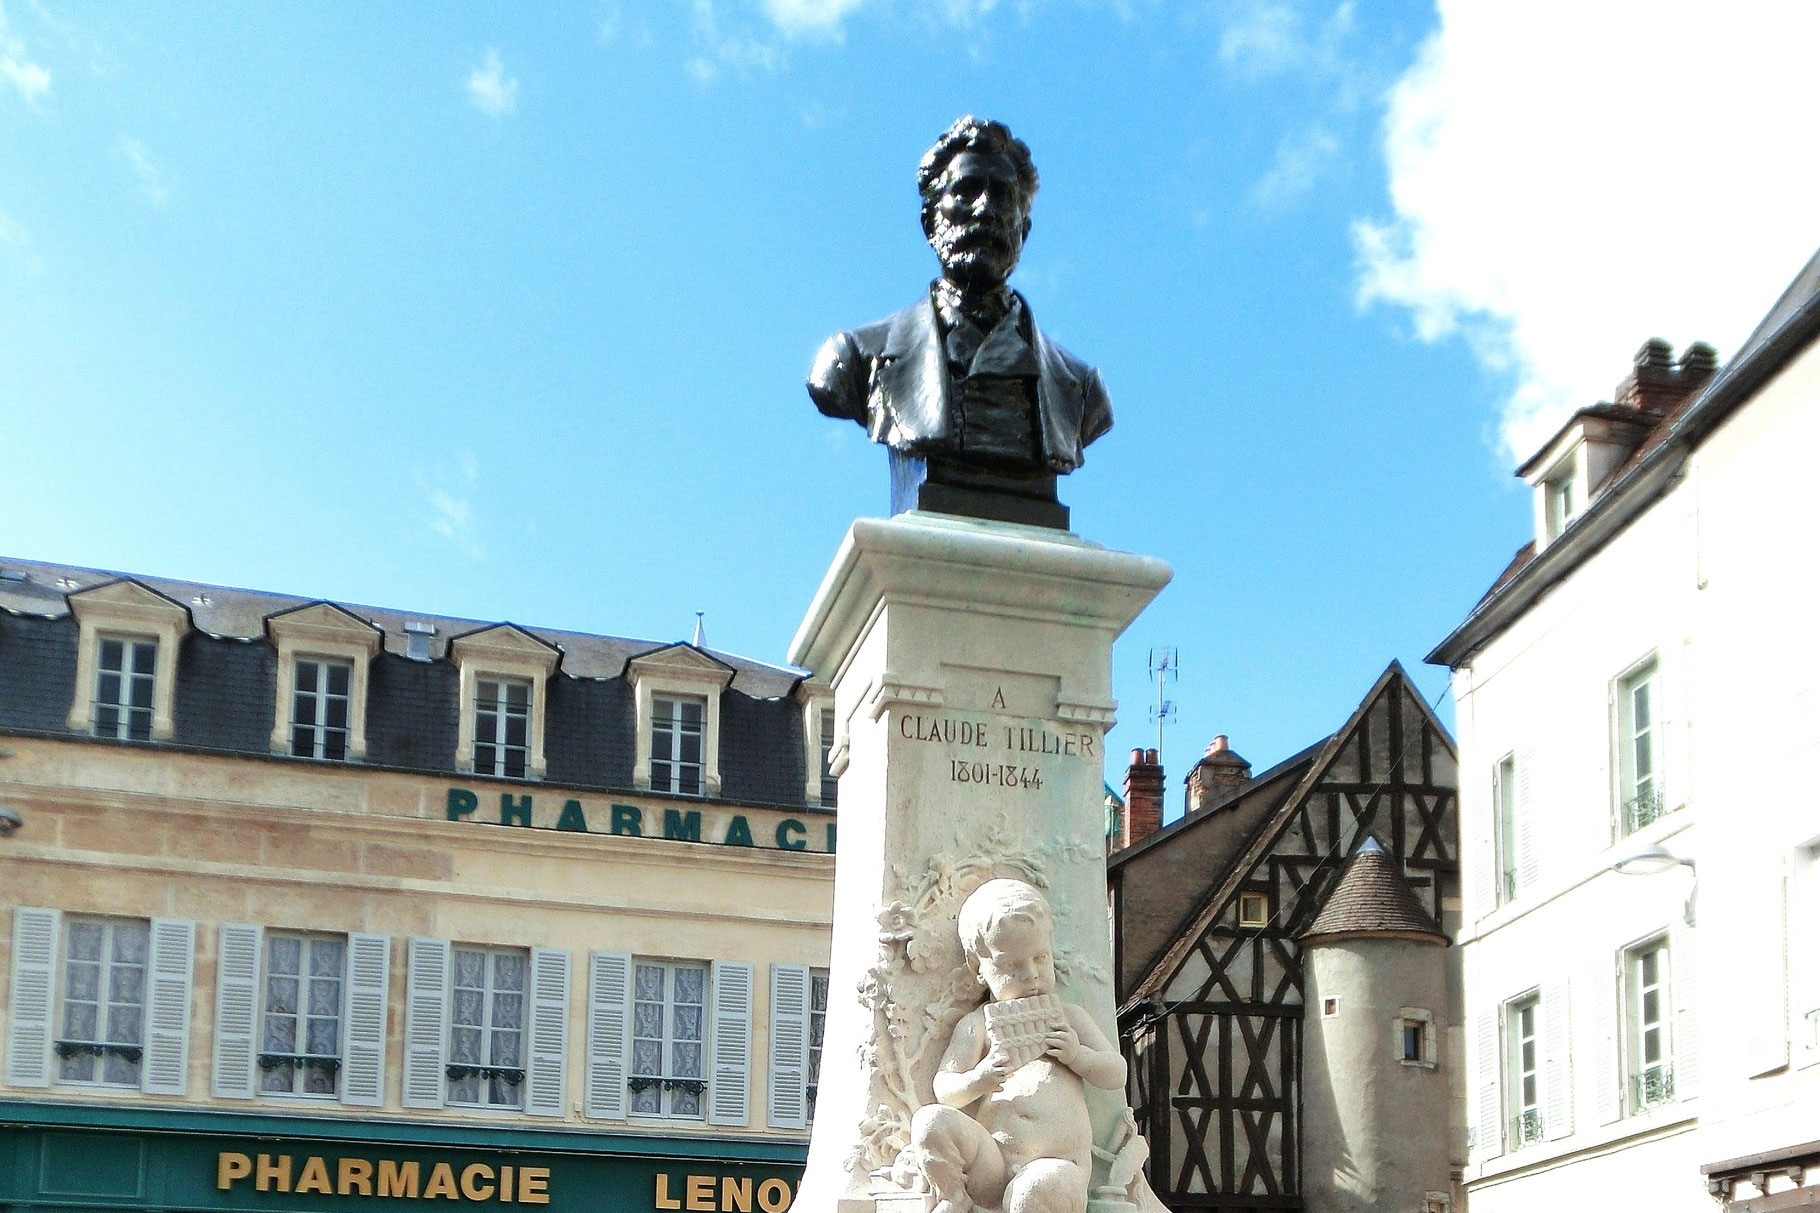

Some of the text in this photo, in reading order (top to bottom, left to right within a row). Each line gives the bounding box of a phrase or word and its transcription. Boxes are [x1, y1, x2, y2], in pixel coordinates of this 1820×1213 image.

[990, 686, 1007, 709] A
[900, 714, 1095, 757] CLAUDE TILLIER
[950, 759, 1044, 790] 1801-1844
[217, 1151, 551, 1205] PHARMACIE
